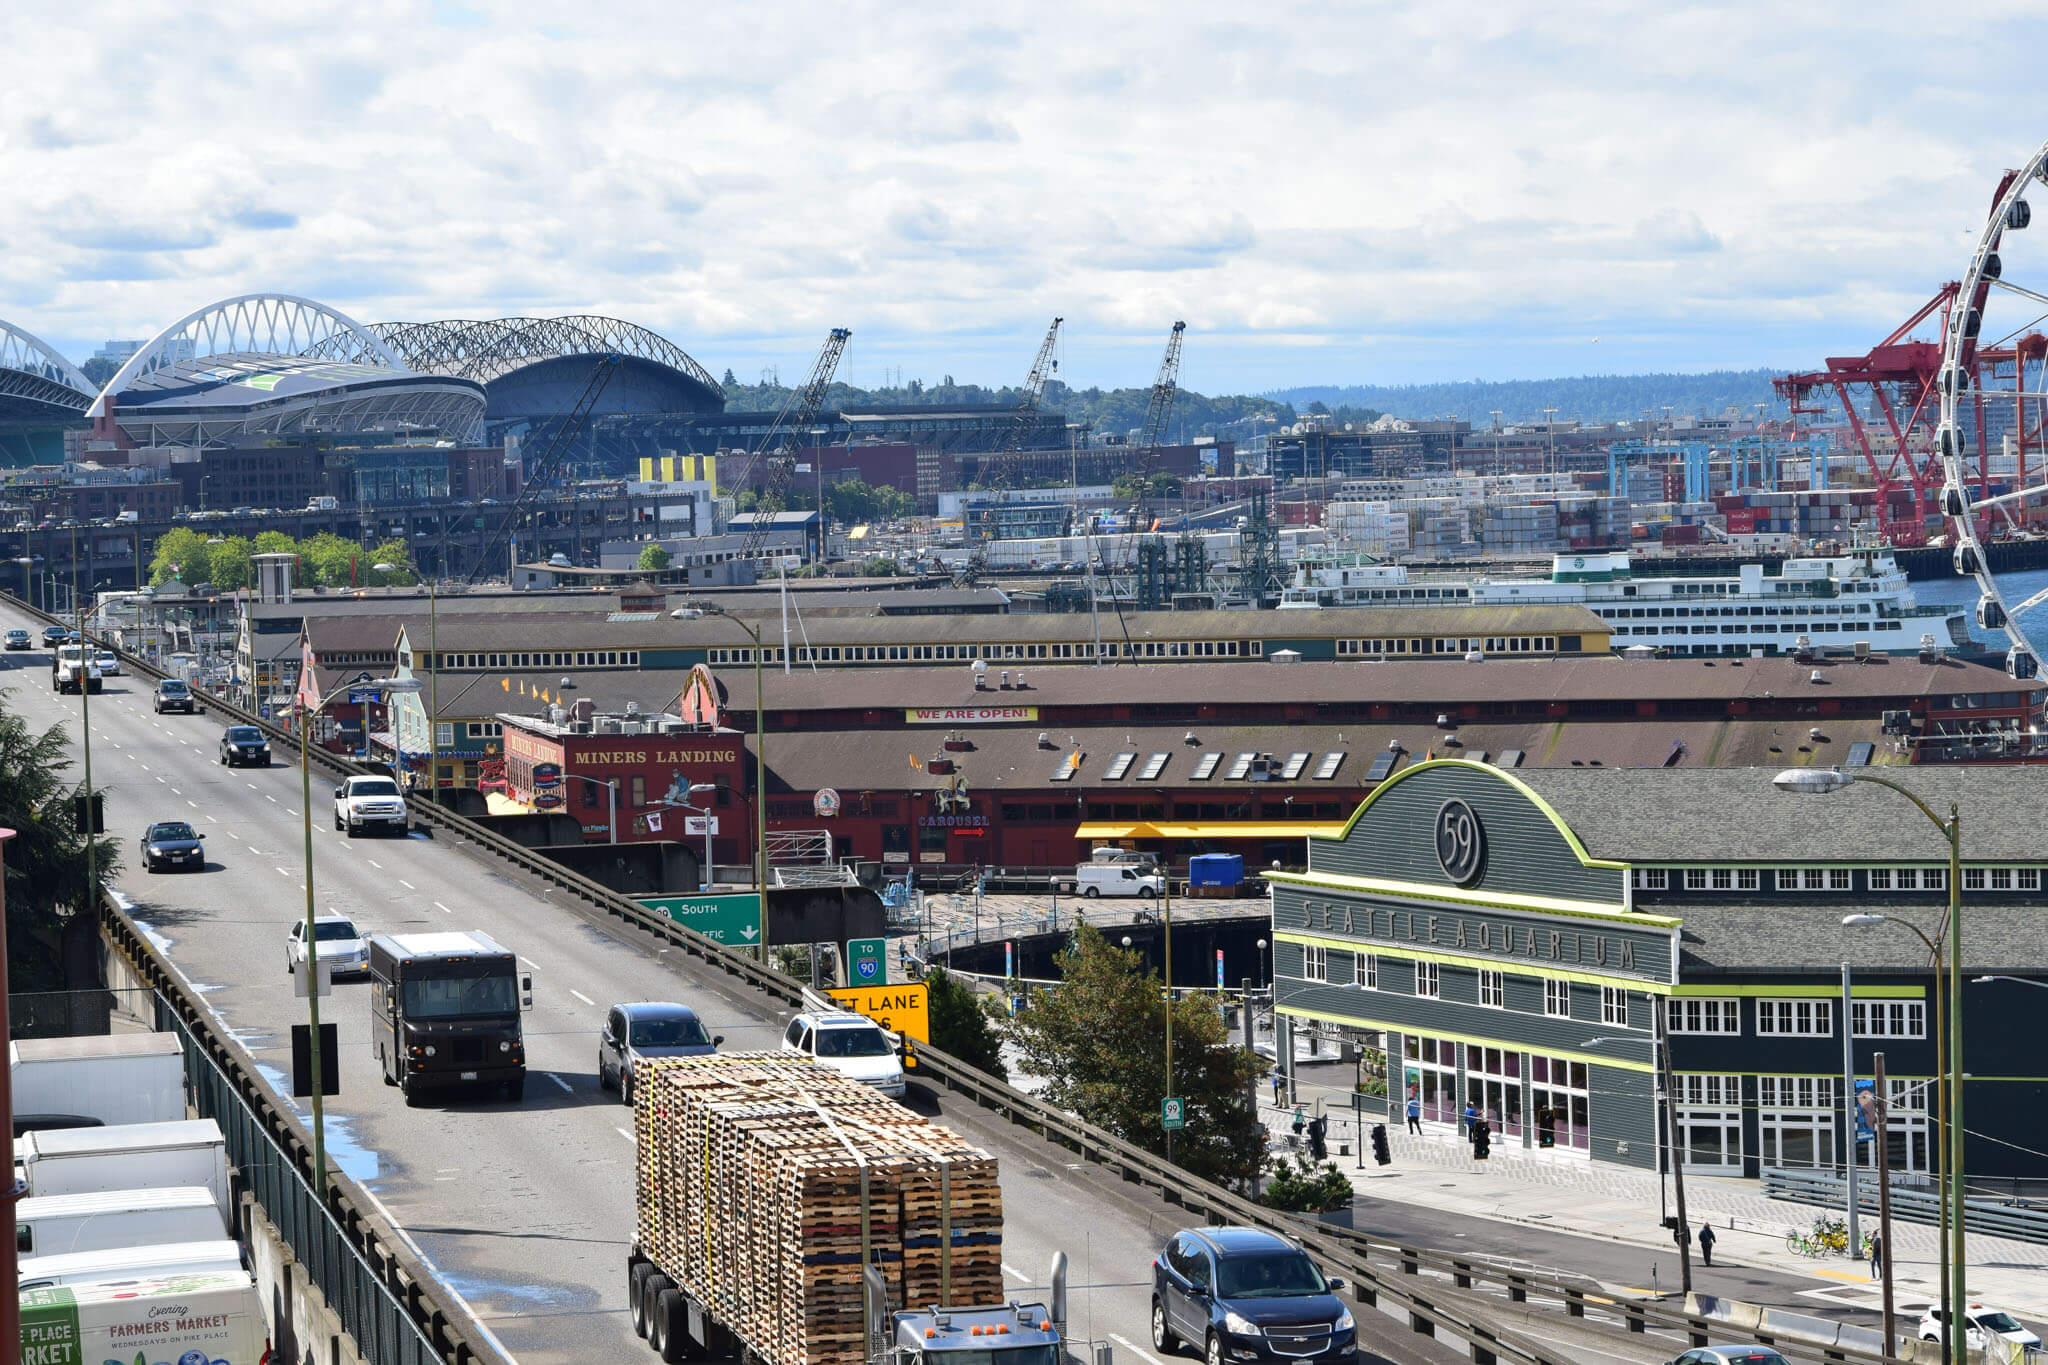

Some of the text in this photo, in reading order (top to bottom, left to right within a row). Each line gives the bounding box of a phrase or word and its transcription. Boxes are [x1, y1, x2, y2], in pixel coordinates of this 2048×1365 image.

[916, 709, 1027, 719] WE ARE OPEN!
[575, 750, 737, 764] MINERS LANDING
[919, 815, 990, 826] CAROUSEL
[1443, 812, 1473, 869] 59
[1303, 900, 1636, 970] SEATTLE AQUARIUM
[861, 944, 874, 954] TO
[861, 963, 875, 974] 90
[869, 995, 919, 1011] LANE
[1167, 1104, 1177, 1113] 99
[148, 1304, 189, 1318] Evening
[30, 1325, 72, 1342] PLACE
[110, 1314, 230, 1338] FARMERS MARKET
[111, 1337, 167, 1349] WEDNESDAYS
[184, 1334, 201, 1342] PIKE
[204, 1331, 229, 1340] PLACE
[21, 1342, 73, 1365] RKET
